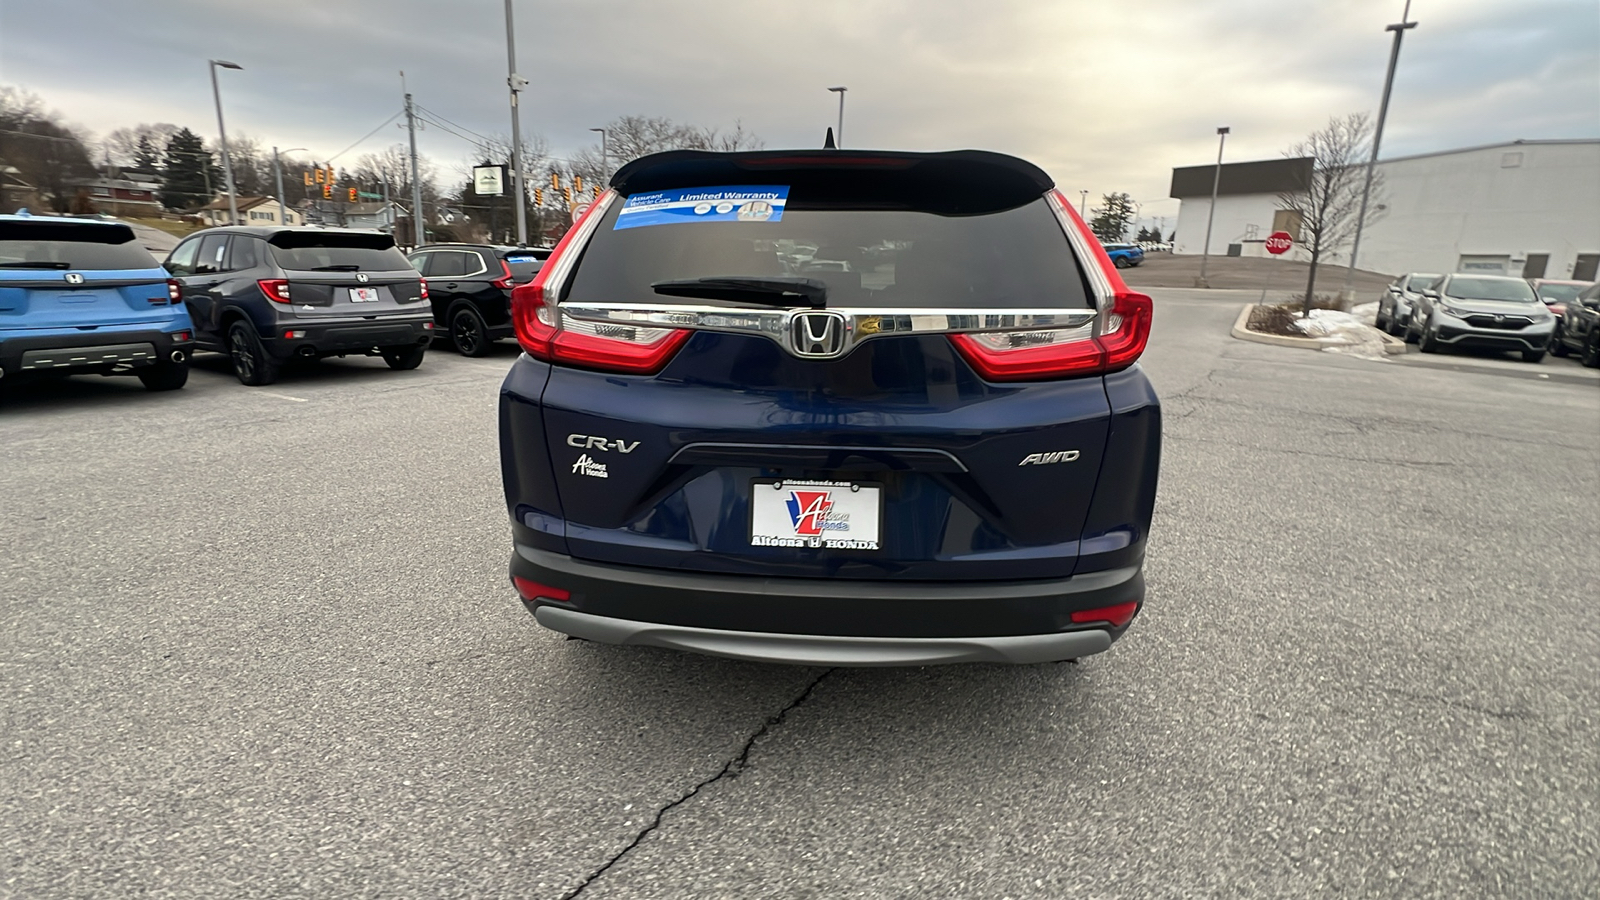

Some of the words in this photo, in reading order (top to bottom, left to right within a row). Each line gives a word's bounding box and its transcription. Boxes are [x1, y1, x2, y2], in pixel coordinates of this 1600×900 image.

[631, 193, 664, 202] Assurant
[679, 192, 722, 202] Limited
[724, 191, 779, 200] Warranty
[630, 199, 654, 207] Vehicle
[1266, 237, 1292, 249] STOP
[566, 433, 641, 453] CR-V
[1018, 450, 1080, 466] AWD
[586, 468, 608, 478] Honda
[816, 521, 850, 531] Honda
[751, 536, 804, 547] Altoona
[825, 539, 879, 550] HONDA
